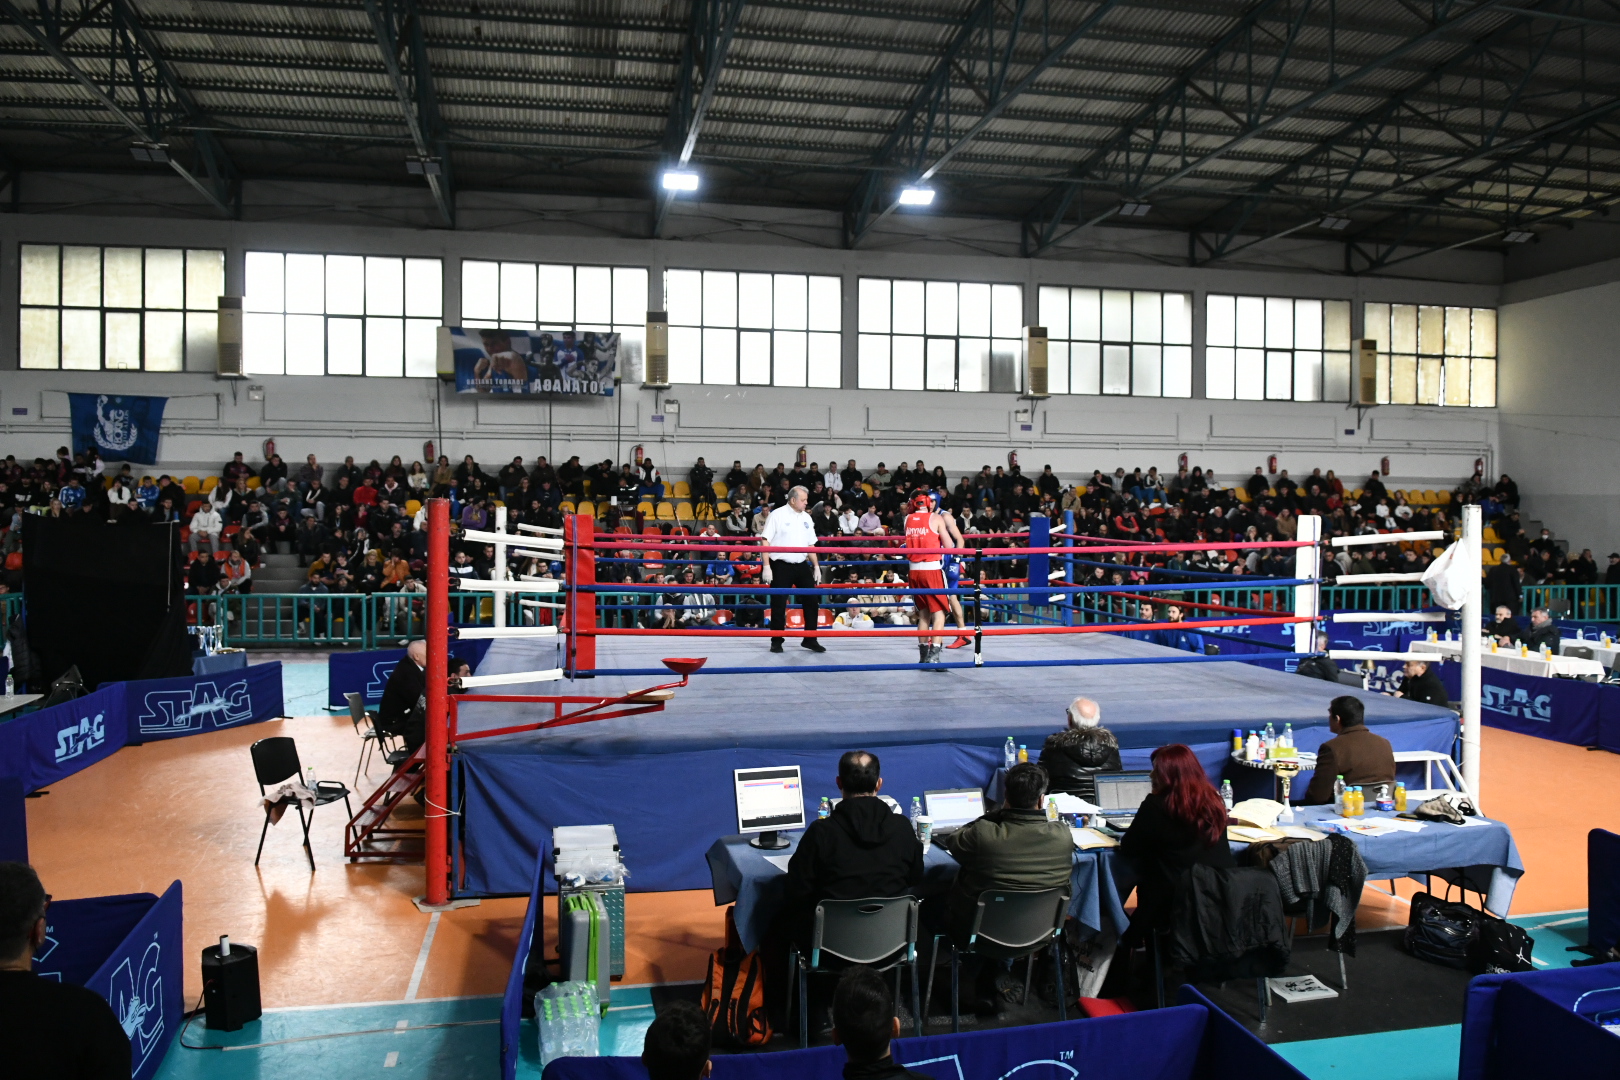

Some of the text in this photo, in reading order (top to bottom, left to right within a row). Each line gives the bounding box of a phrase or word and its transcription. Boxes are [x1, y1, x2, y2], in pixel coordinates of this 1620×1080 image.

[534, 378, 606, 394] ΑΘΑΝΑΤΟΣ
[114, 409, 124, 444] BOXING
[139, 681, 252, 734] STAG
[1481, 684, 1551, 722] STAG
[54, 714, 105, 763] STAG
